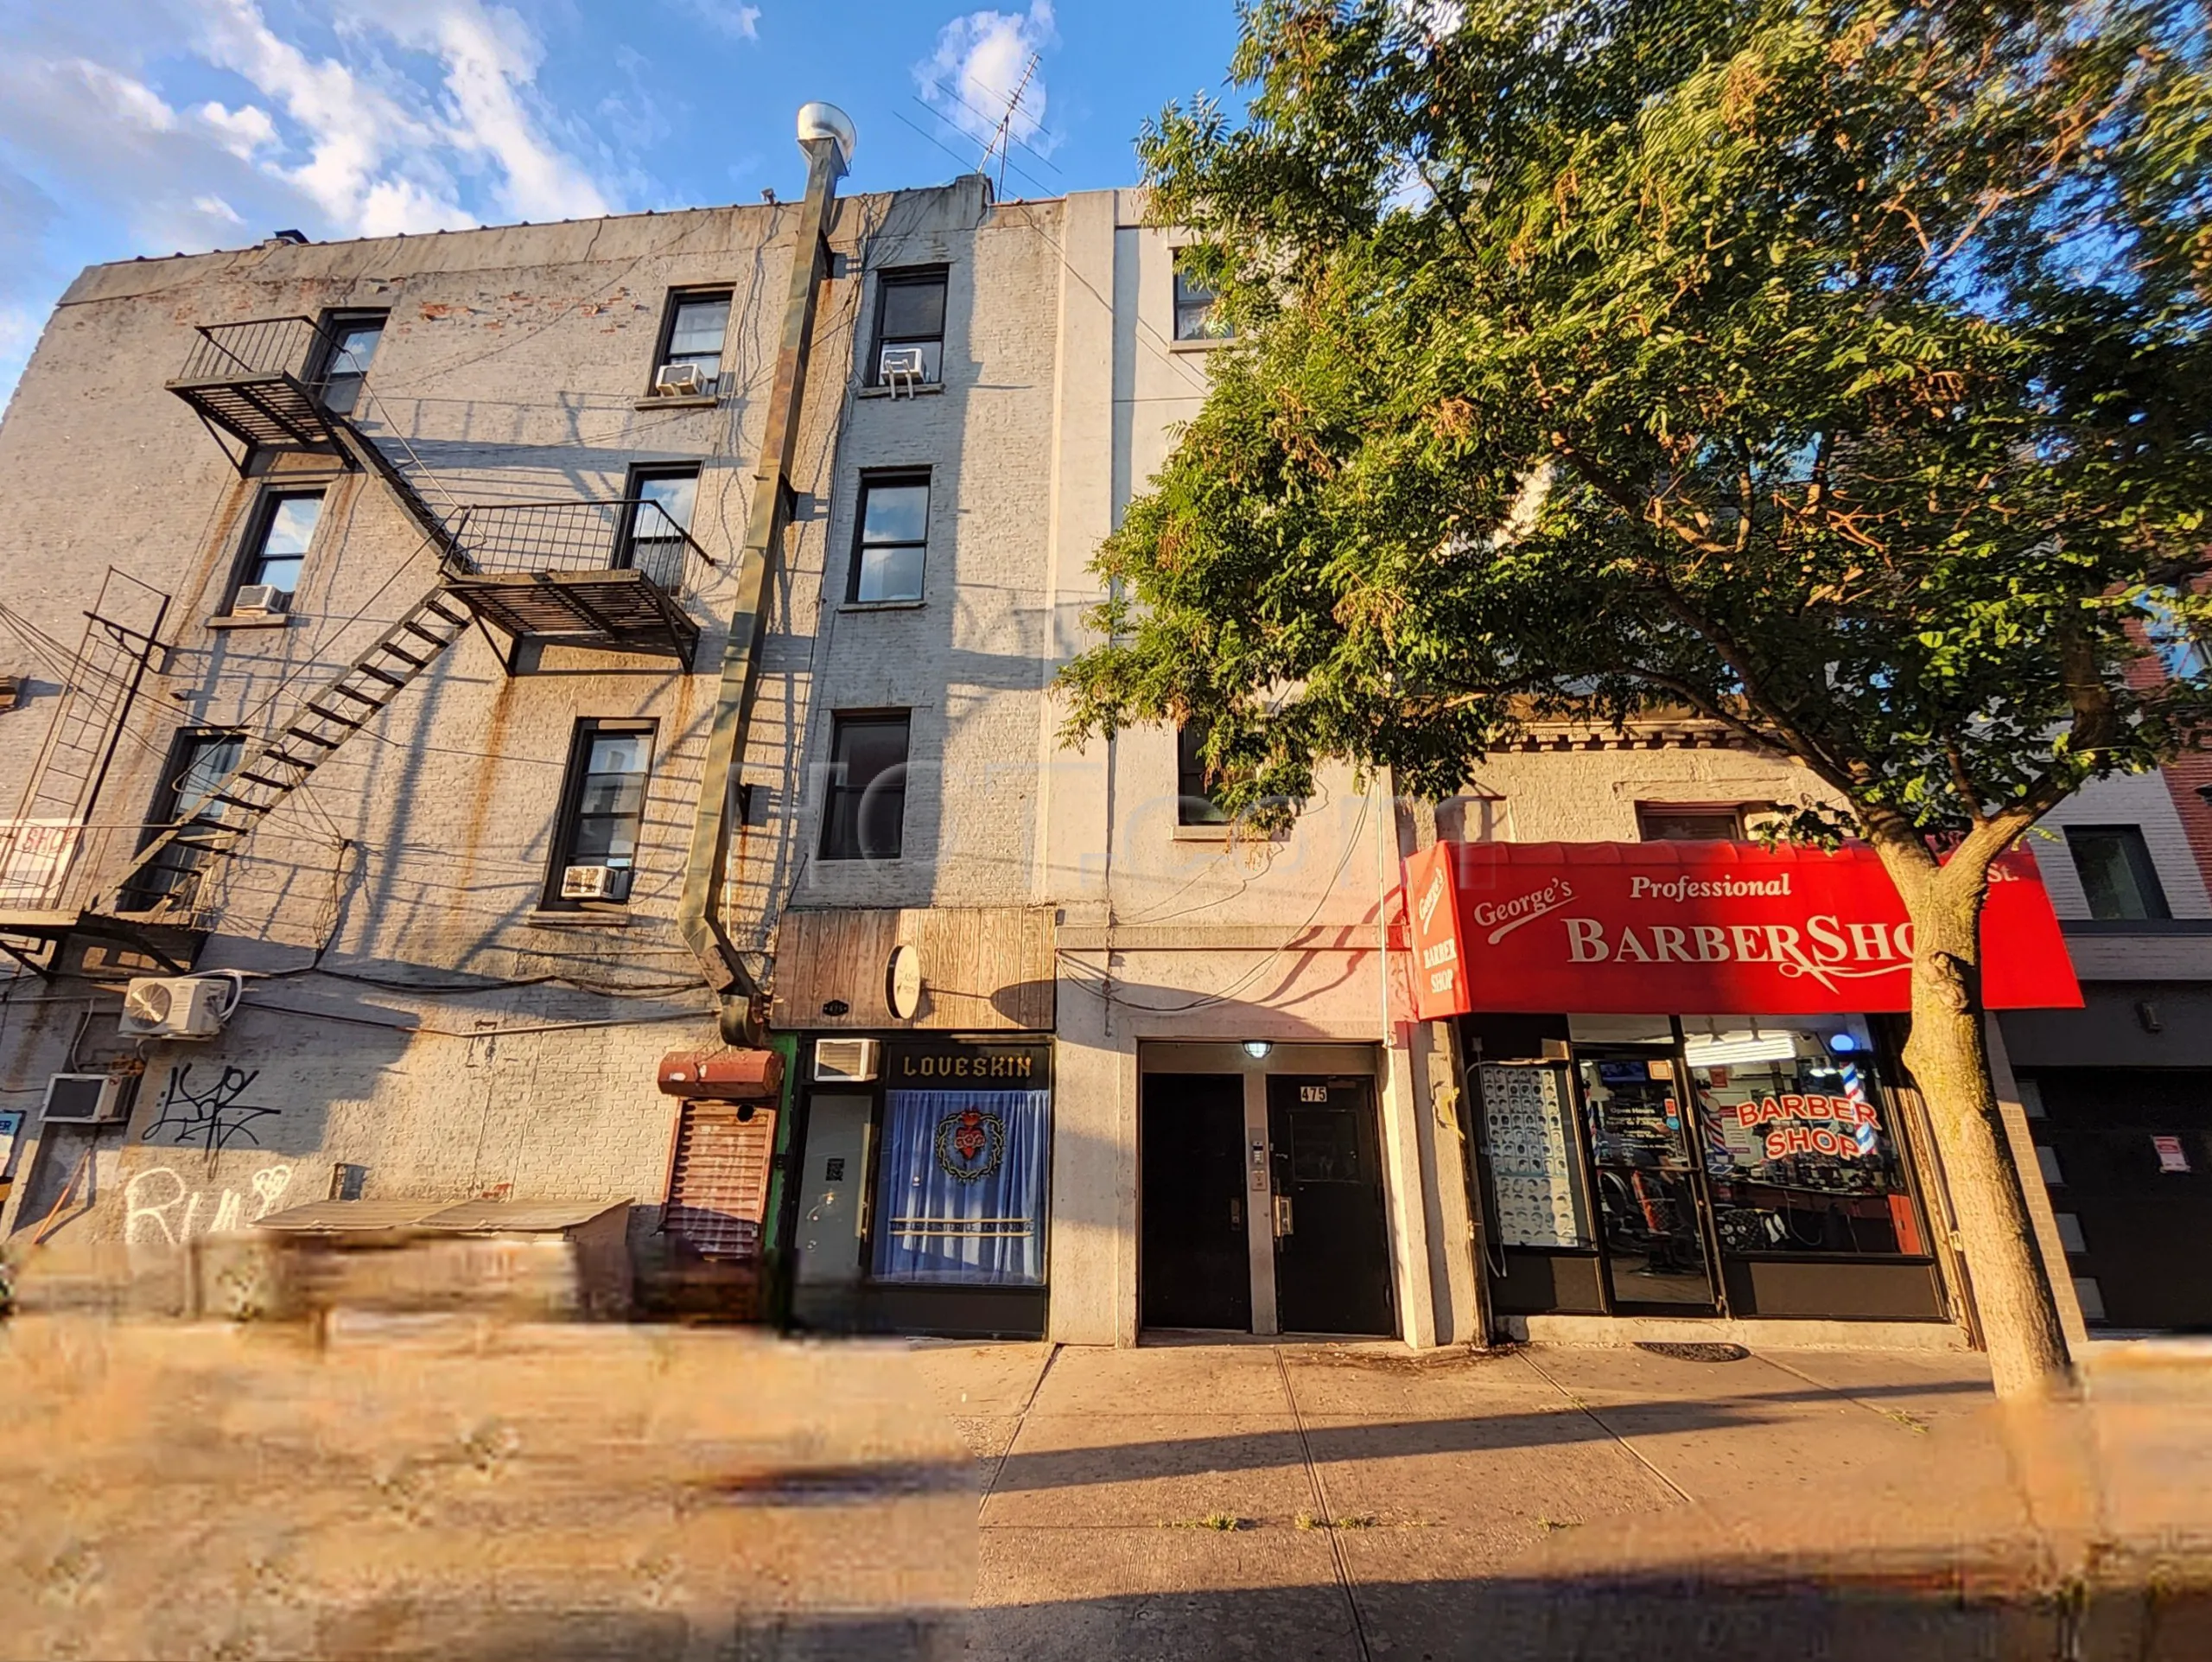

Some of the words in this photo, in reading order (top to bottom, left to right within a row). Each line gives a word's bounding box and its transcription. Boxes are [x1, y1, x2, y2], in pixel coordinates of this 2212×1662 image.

[1474, 877, 1574, 928] George's
[1630, 873, 1791, 902] Professional
[1423, 938, 1457, 970] BARBER
[1430, 968, 1453, 993] SHOP
[1302, 1087, 1325, 1101] 475
[1737, 1093, 1882, 1131] BARBER
[1765, 1126, 1861, 1160] SHOP
